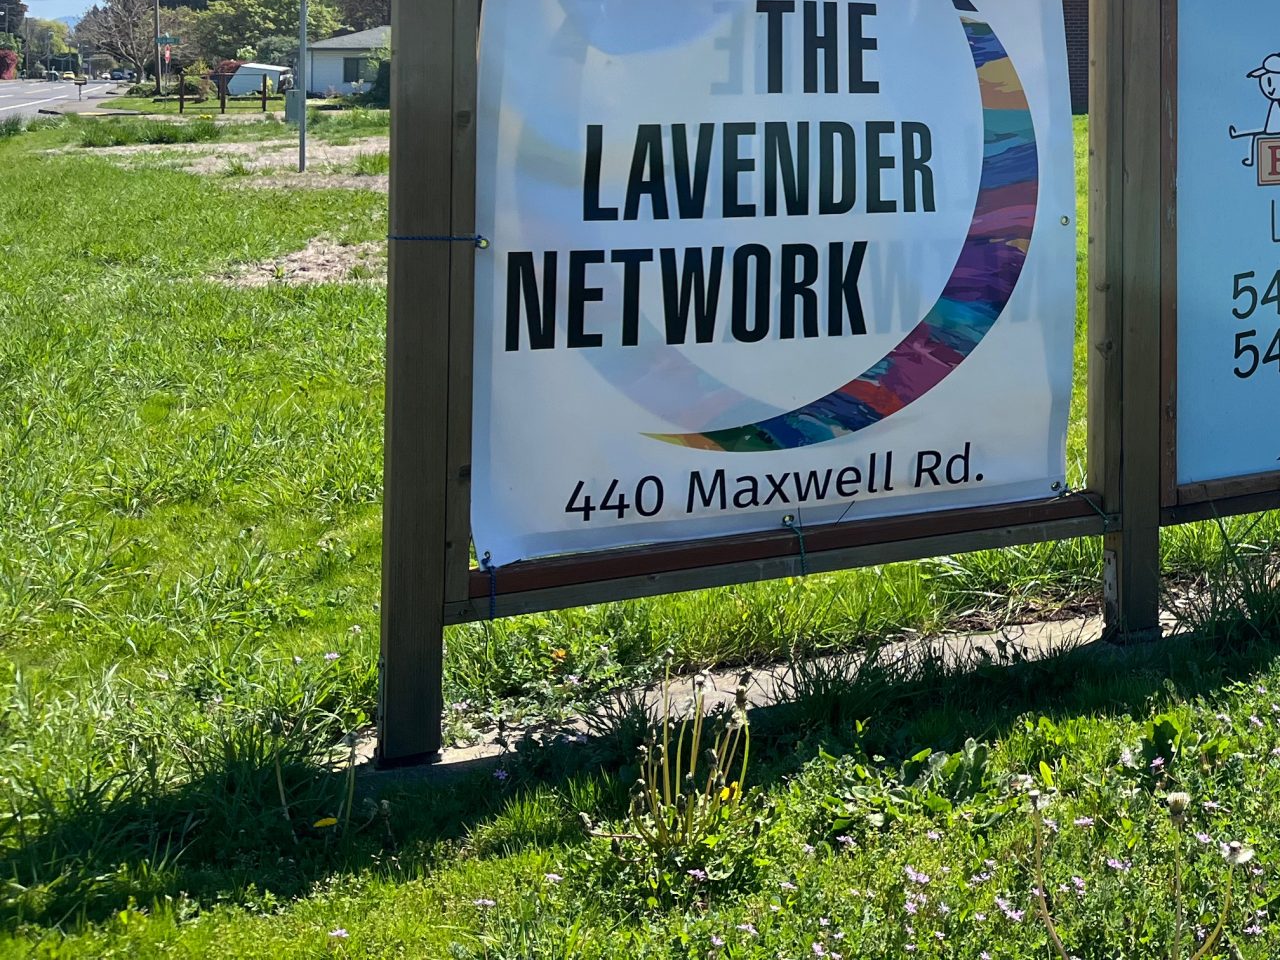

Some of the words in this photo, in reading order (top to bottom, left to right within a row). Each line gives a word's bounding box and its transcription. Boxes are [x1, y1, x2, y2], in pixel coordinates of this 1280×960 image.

[756, 0, 880, 94] THE
[583, 120, 936, 222] LAVENDER
[504, 240, 868, 352] NETWORK
[563, 474, 664, 522] 440
[685, 451, 894, 514] Maxwell
[914, 442, 985, 487] Rd.
